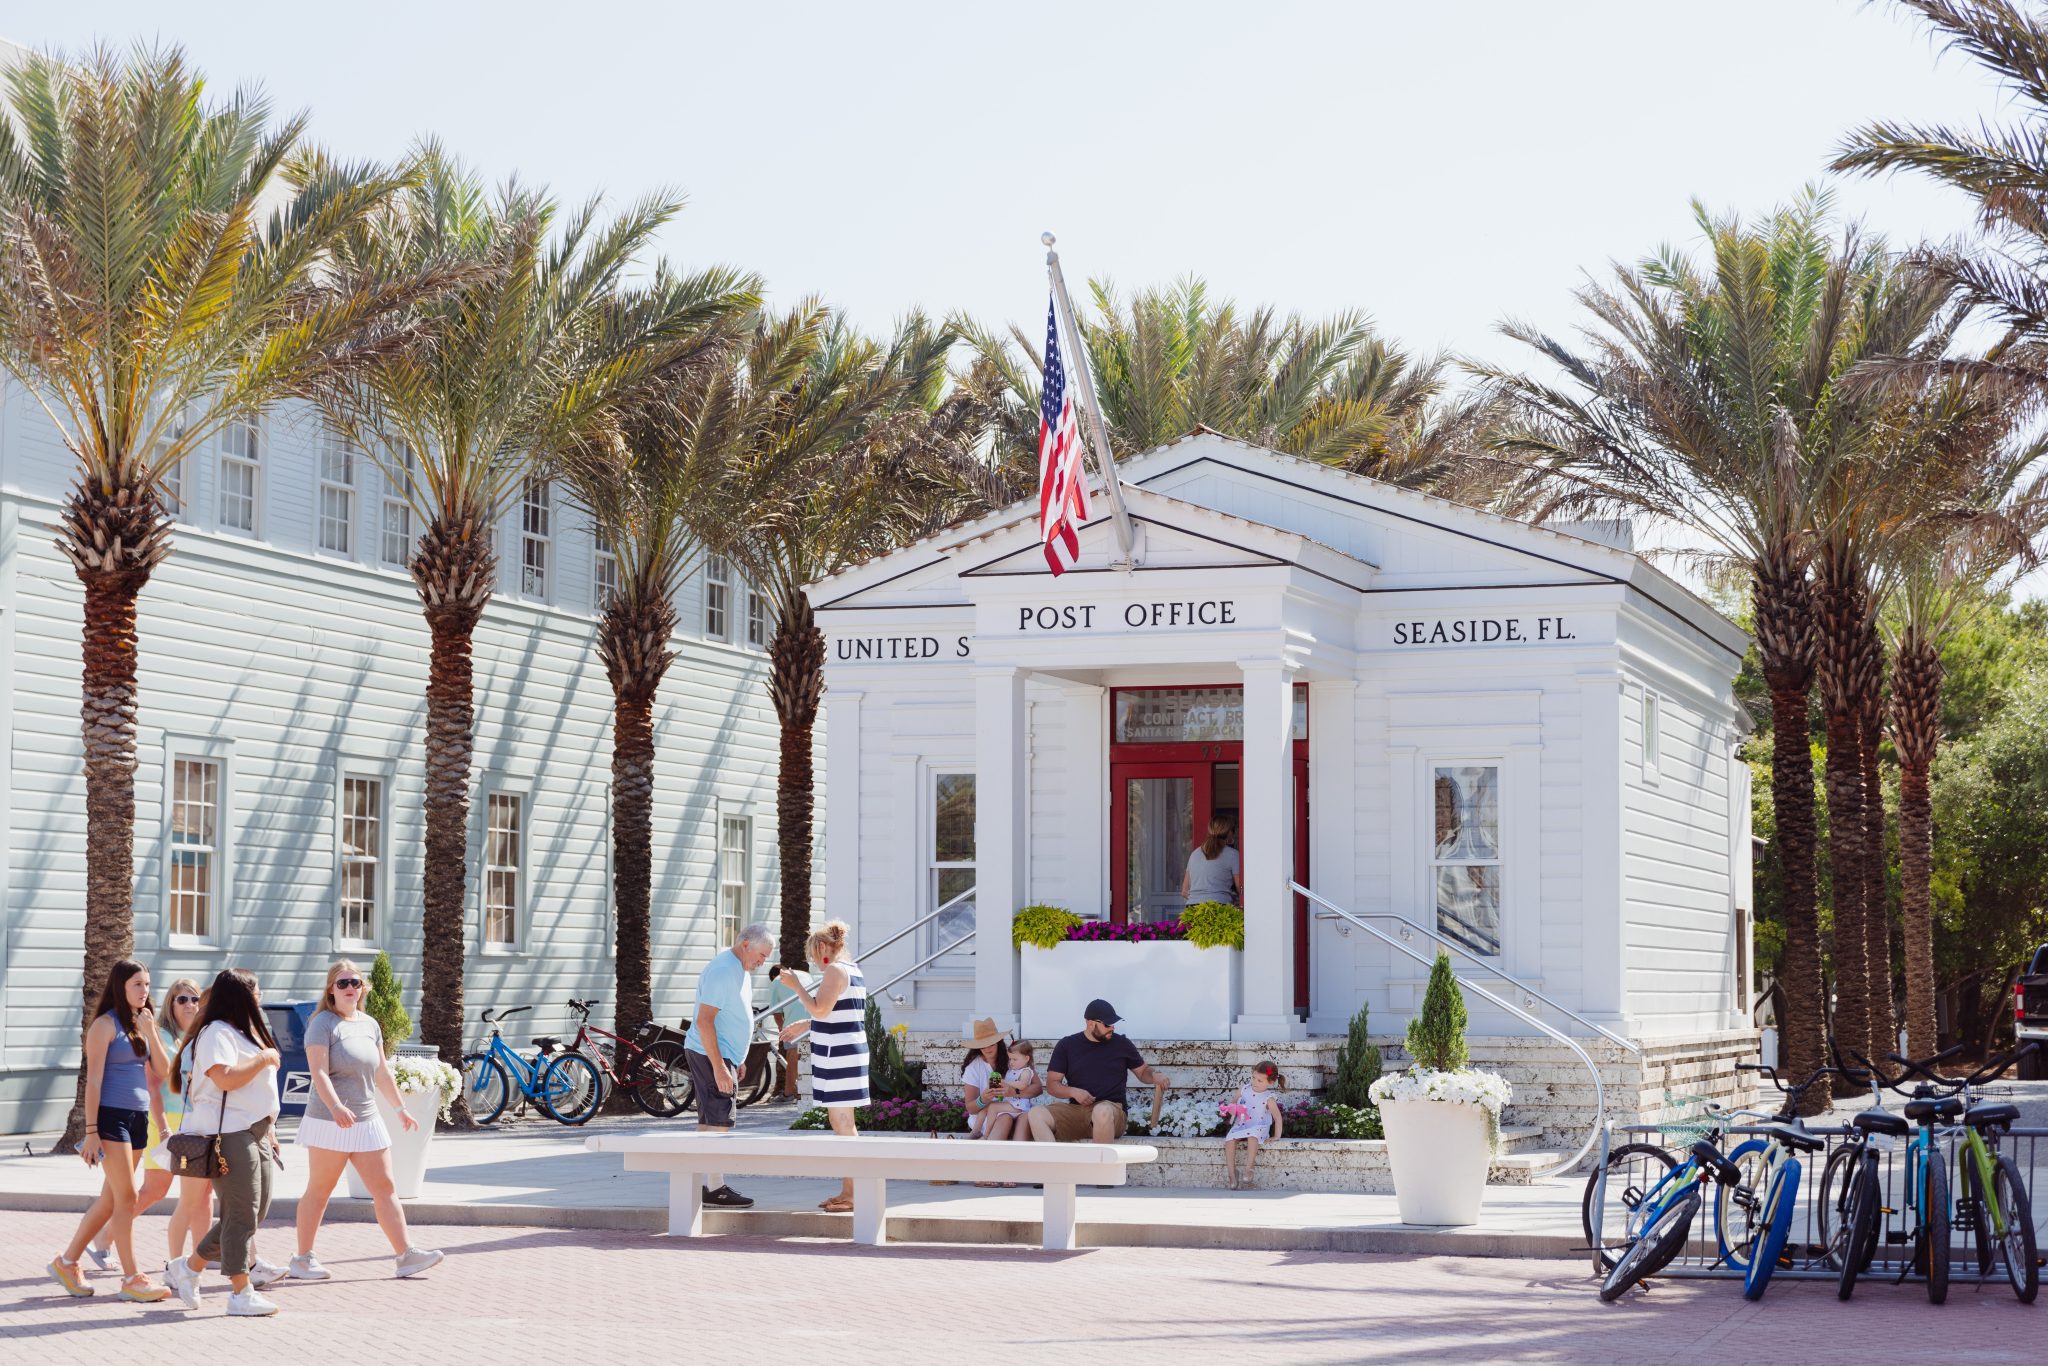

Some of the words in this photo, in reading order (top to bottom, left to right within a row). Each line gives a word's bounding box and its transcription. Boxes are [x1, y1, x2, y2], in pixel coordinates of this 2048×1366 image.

[1019, 605, 1096, 630] POST
[1125, 601, 1236, 627] OFFICE
[1393, 618, 1527, 645] SEASIDE,
[1538, 617, 1576, 640] FL.
[837, 636, 939, 660] UNITED
[1166, 695, 1244, 710] SEASID
[1143, 710, 1216, 726] CONTRACT
[1127, 727, 1162, 738] SANTA
[1166, 726, 1194, 737] ROSA
[1199, 726, 1236, 737] BEACH
[1201, 744, 1222, 761] 99
